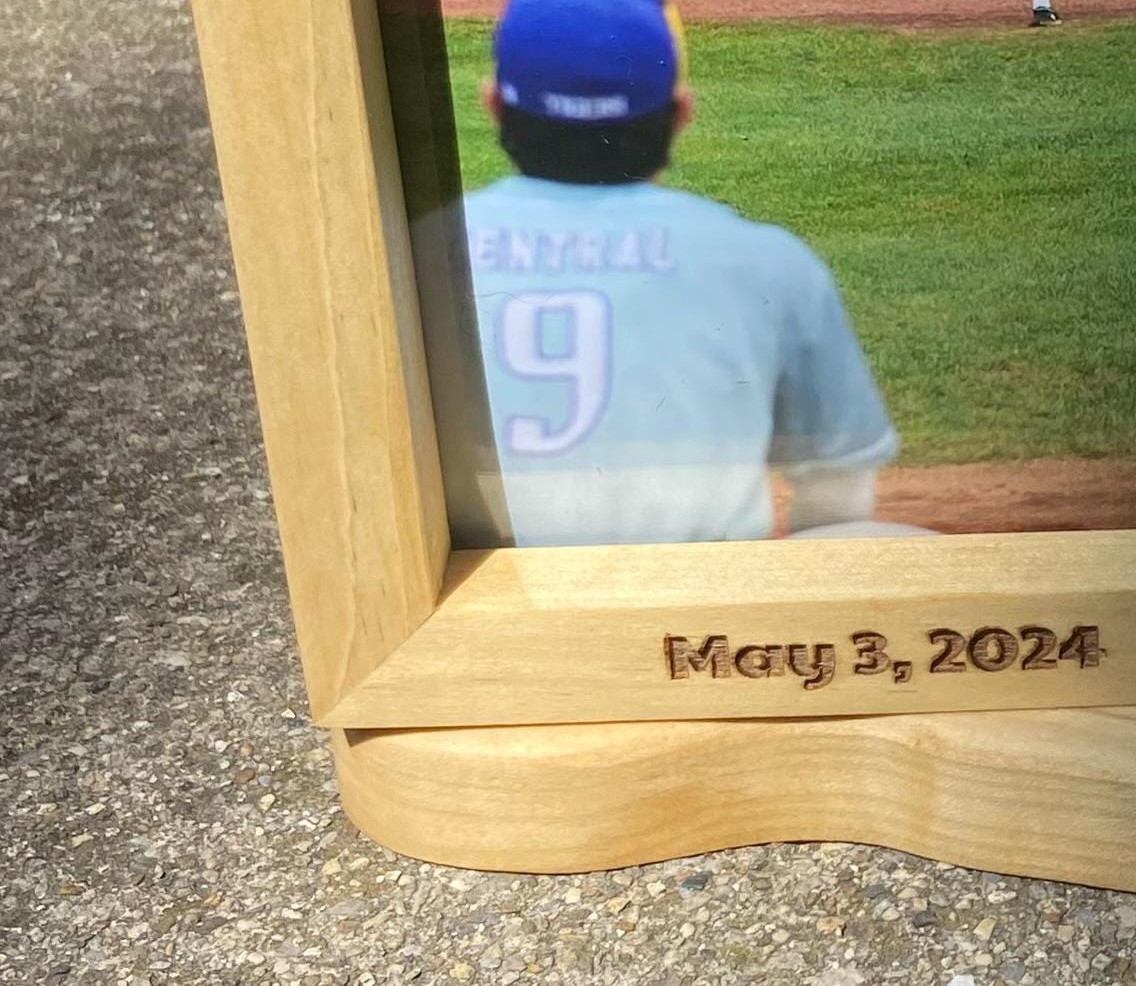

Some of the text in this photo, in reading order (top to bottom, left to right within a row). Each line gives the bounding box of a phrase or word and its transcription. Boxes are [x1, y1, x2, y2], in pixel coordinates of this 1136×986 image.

[499, 289, 613, 458] 9
[665, 624, 1107, 690] May 3, 2024
